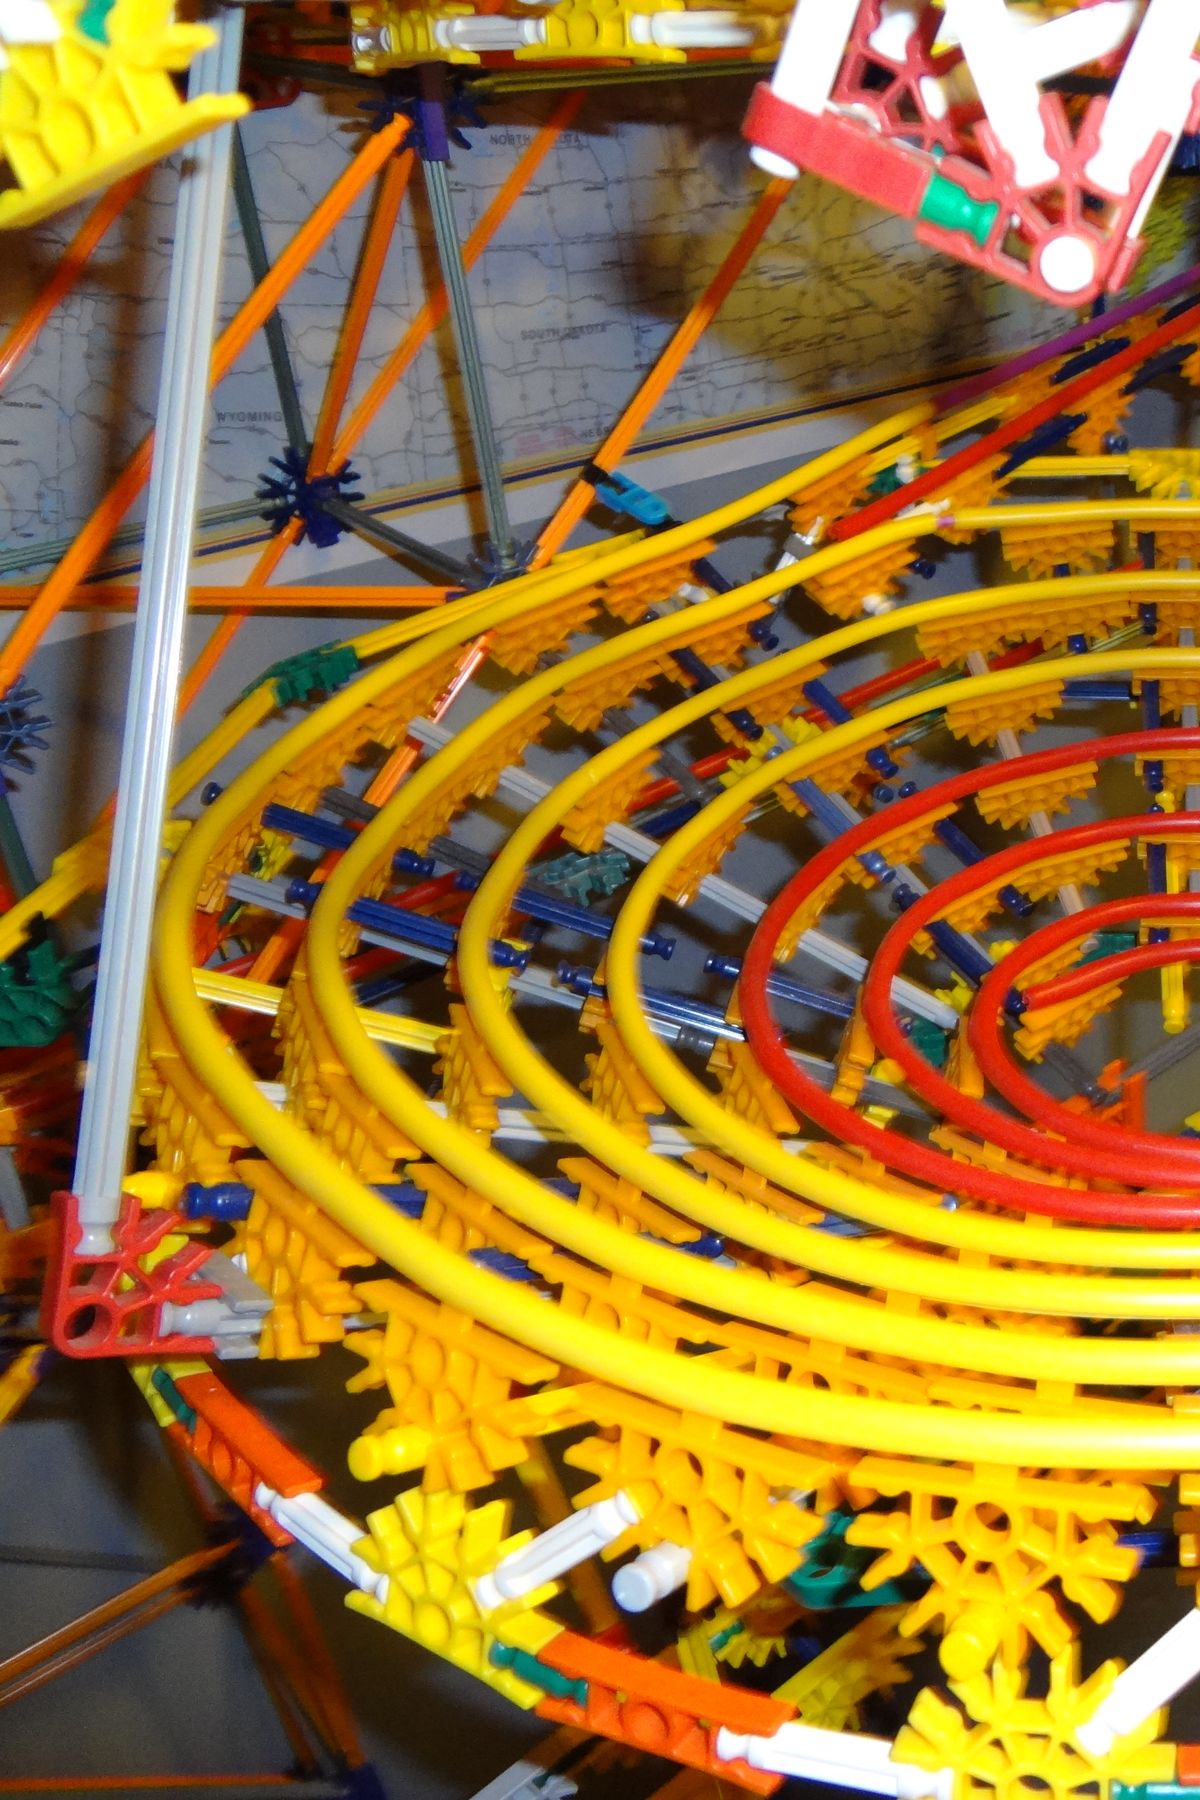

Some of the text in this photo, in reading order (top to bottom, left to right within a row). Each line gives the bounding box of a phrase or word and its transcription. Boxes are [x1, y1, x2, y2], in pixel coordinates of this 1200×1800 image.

[489, 133, 533, 147] NORTH
[520, 327, 560, 341] SOUTH
[216, 411, 283, 422] WYOMING
